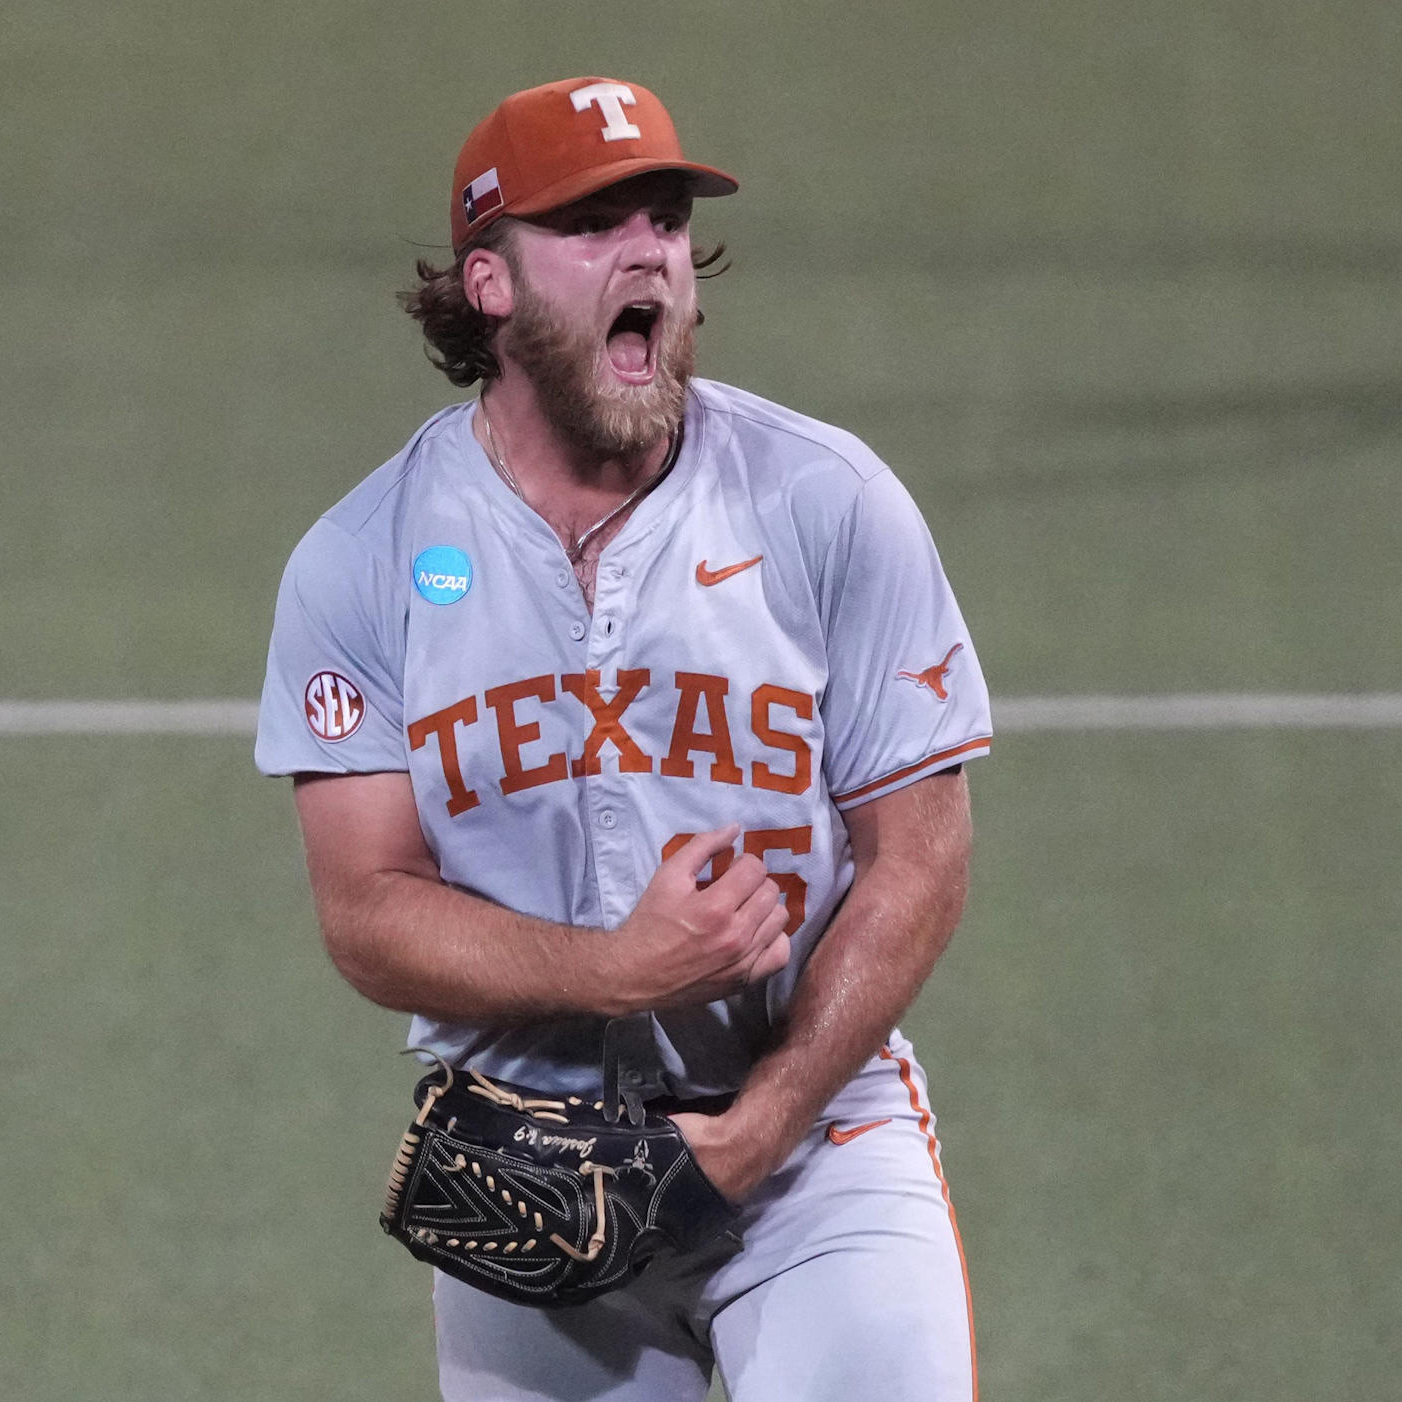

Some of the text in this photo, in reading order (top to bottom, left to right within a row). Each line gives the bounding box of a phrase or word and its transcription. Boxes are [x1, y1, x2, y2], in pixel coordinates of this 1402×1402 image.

[569, 82, 641, 143] T
[418, 570, 468, 592] NCAA
[307, 674, 360, 737] SEC
[407, 668, 813, 818] TEXAS
[541, 1136, 597, 1158] Joshua
